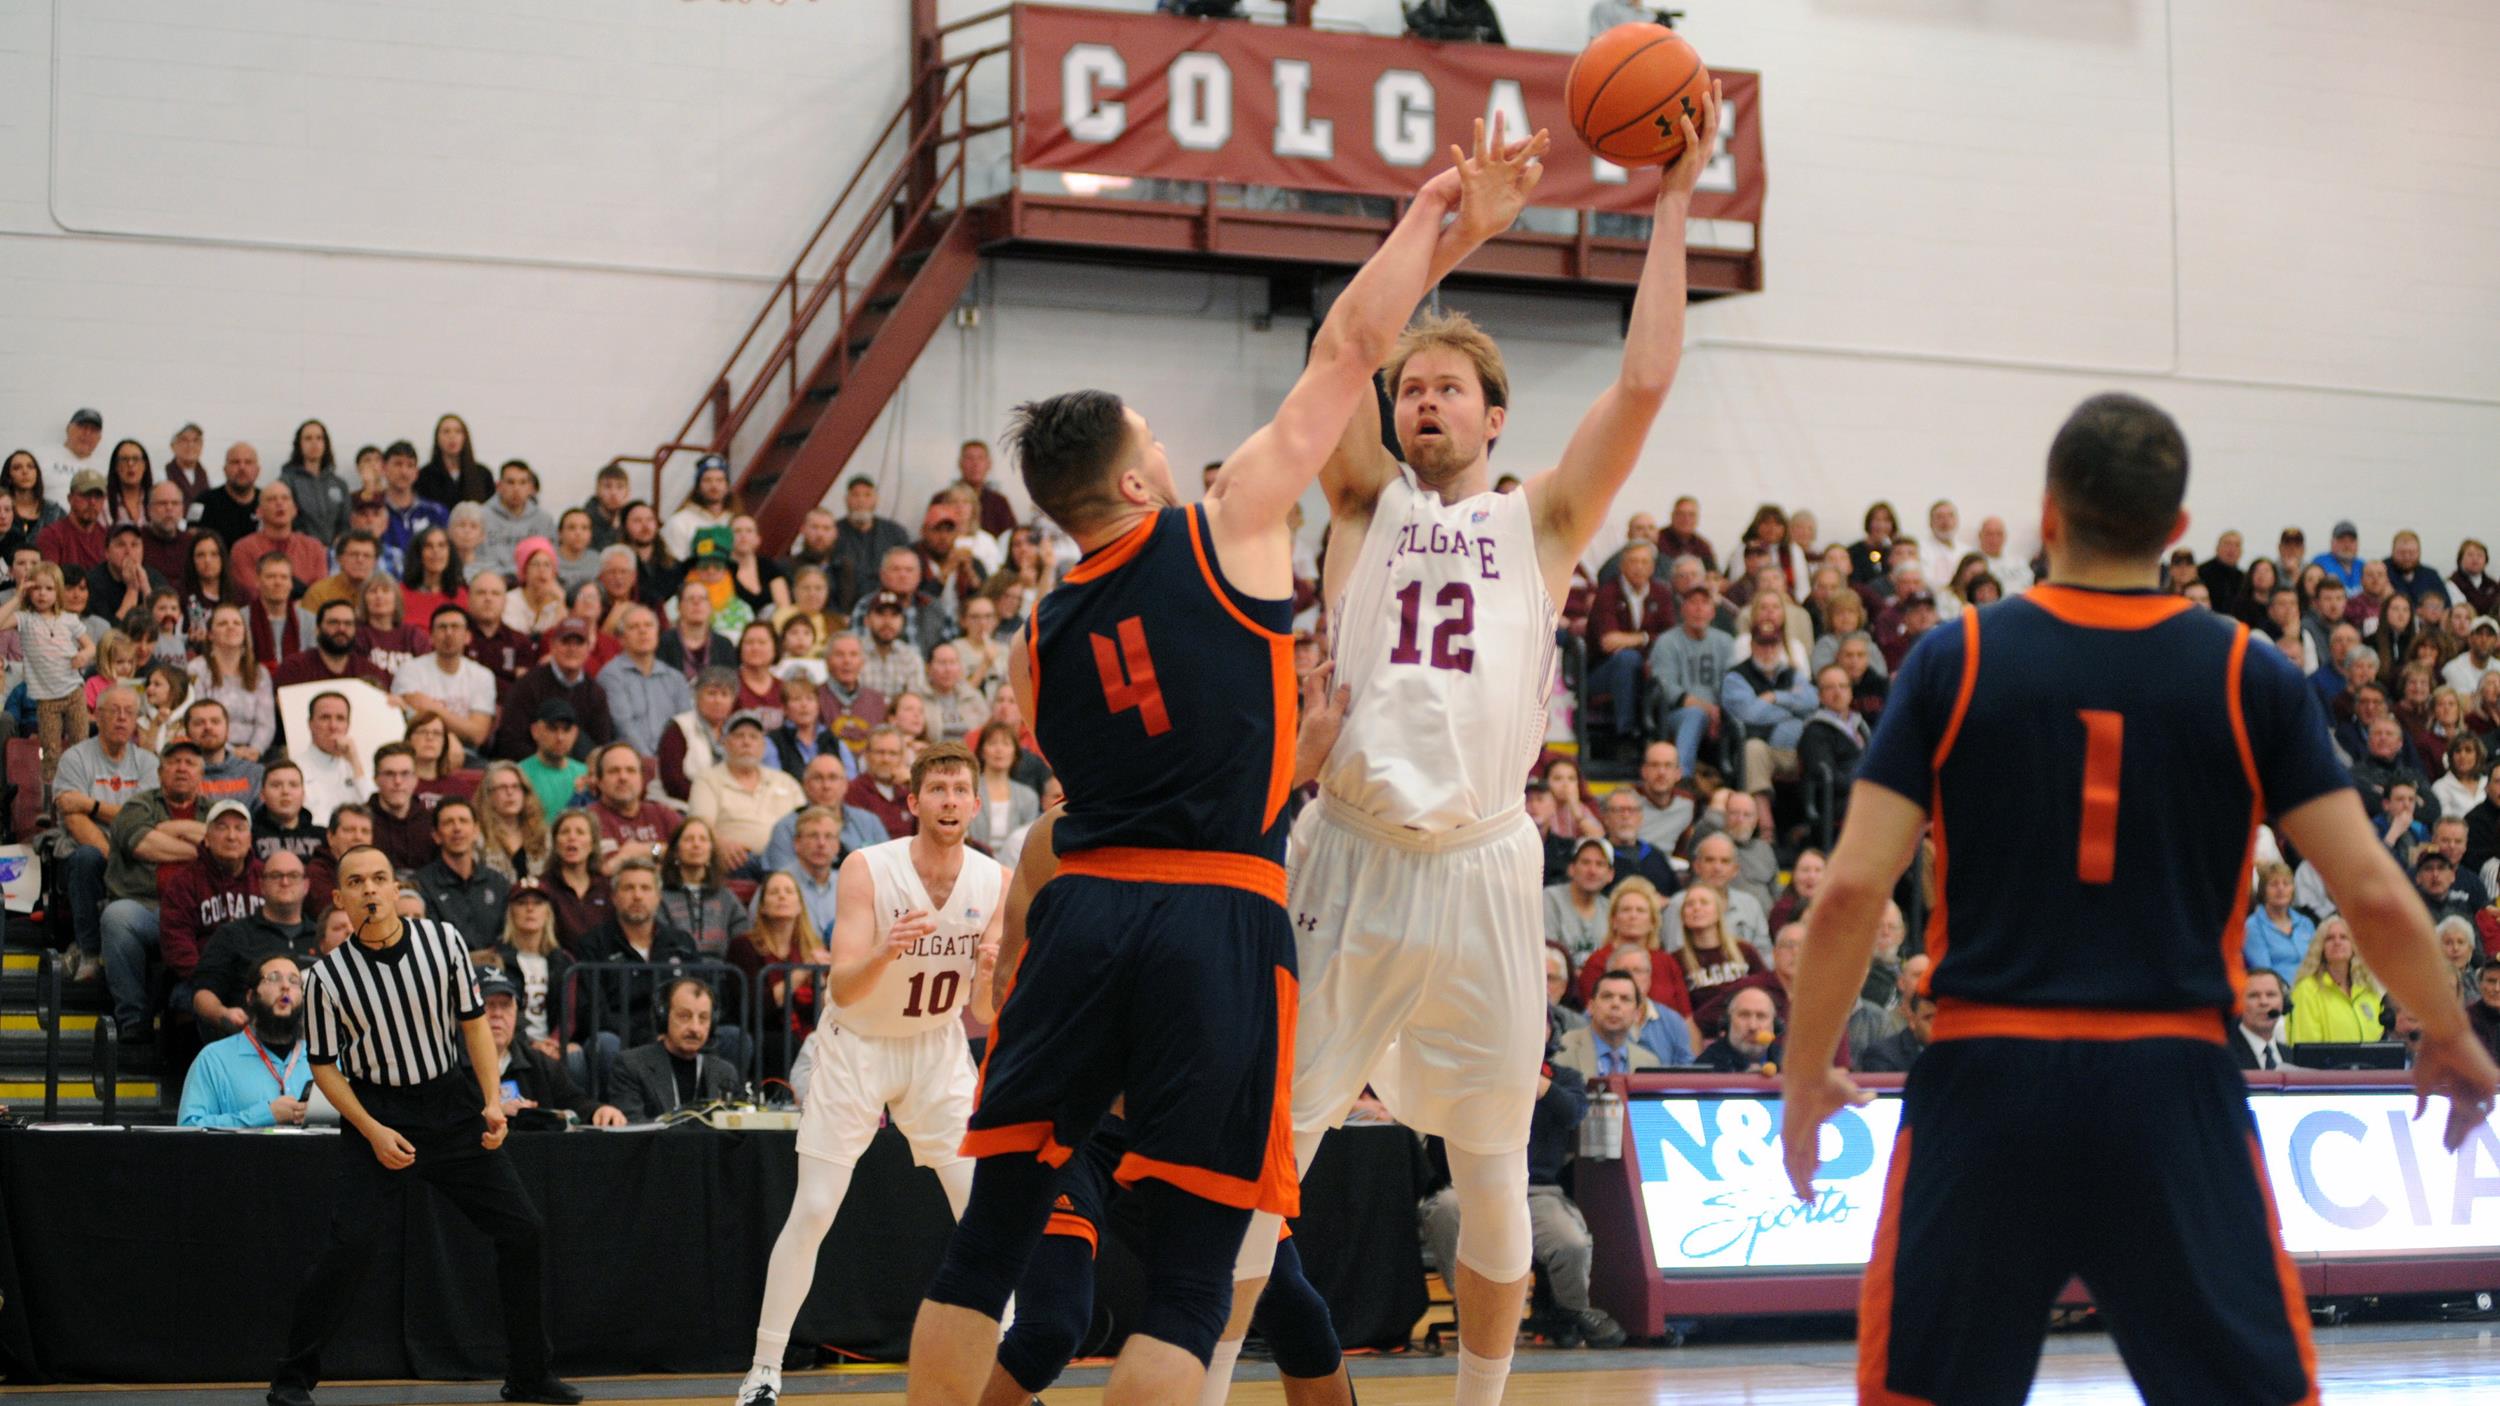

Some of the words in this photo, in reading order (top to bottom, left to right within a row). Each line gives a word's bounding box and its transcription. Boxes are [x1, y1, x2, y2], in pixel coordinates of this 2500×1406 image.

[1061, 42, 1738, 194] COLGAE
[1390, 579, 1475, 675] 12
[1088, 615, 1174, 737] 4
[2075, 708, 2125, 884] 1
[200, 891, 266, 926] COLGAT
[902, 970, 961, 1018] 10
[1680, 1185, 1861, 1267] Sports
